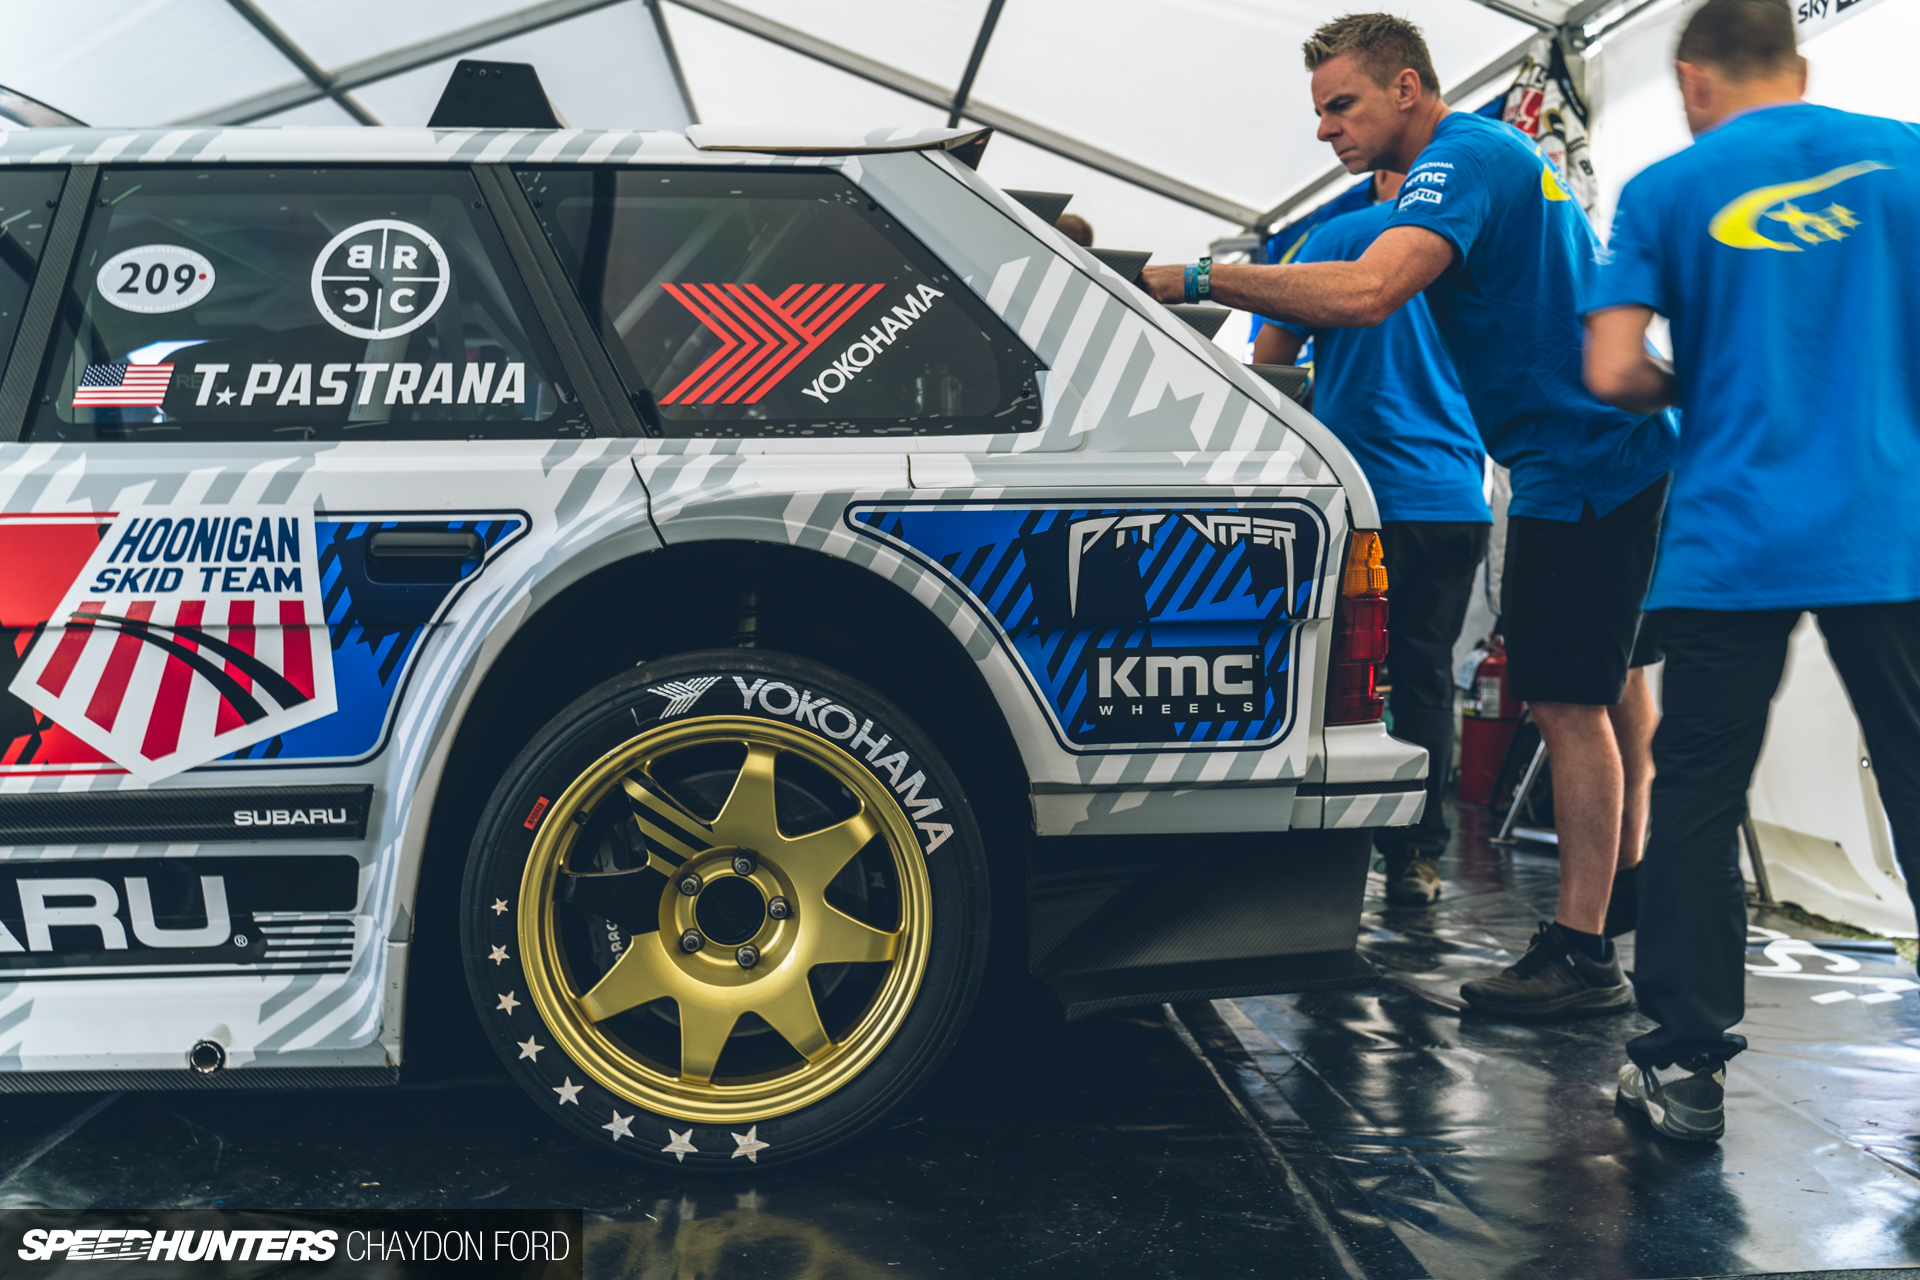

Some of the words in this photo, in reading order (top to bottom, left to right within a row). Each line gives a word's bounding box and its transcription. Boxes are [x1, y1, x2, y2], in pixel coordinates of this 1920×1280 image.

[116, 262, 196, 296] 209
[801, 283, 945, 404] YOKOHAMA
[106, 517, 301, 564] HOONIGAN
[89, 568, 184, 593] SKID
[199, 567, 304, 593] TEAM
[1182, 514, 1297, 617] VIPER
[1099, 702, 1254, 716] WHEELS
[732, 675, 955, 856] YOKOHAMA
[233, 808, 347, 826] SUBARU
[0, 874, 232, 952] RU
